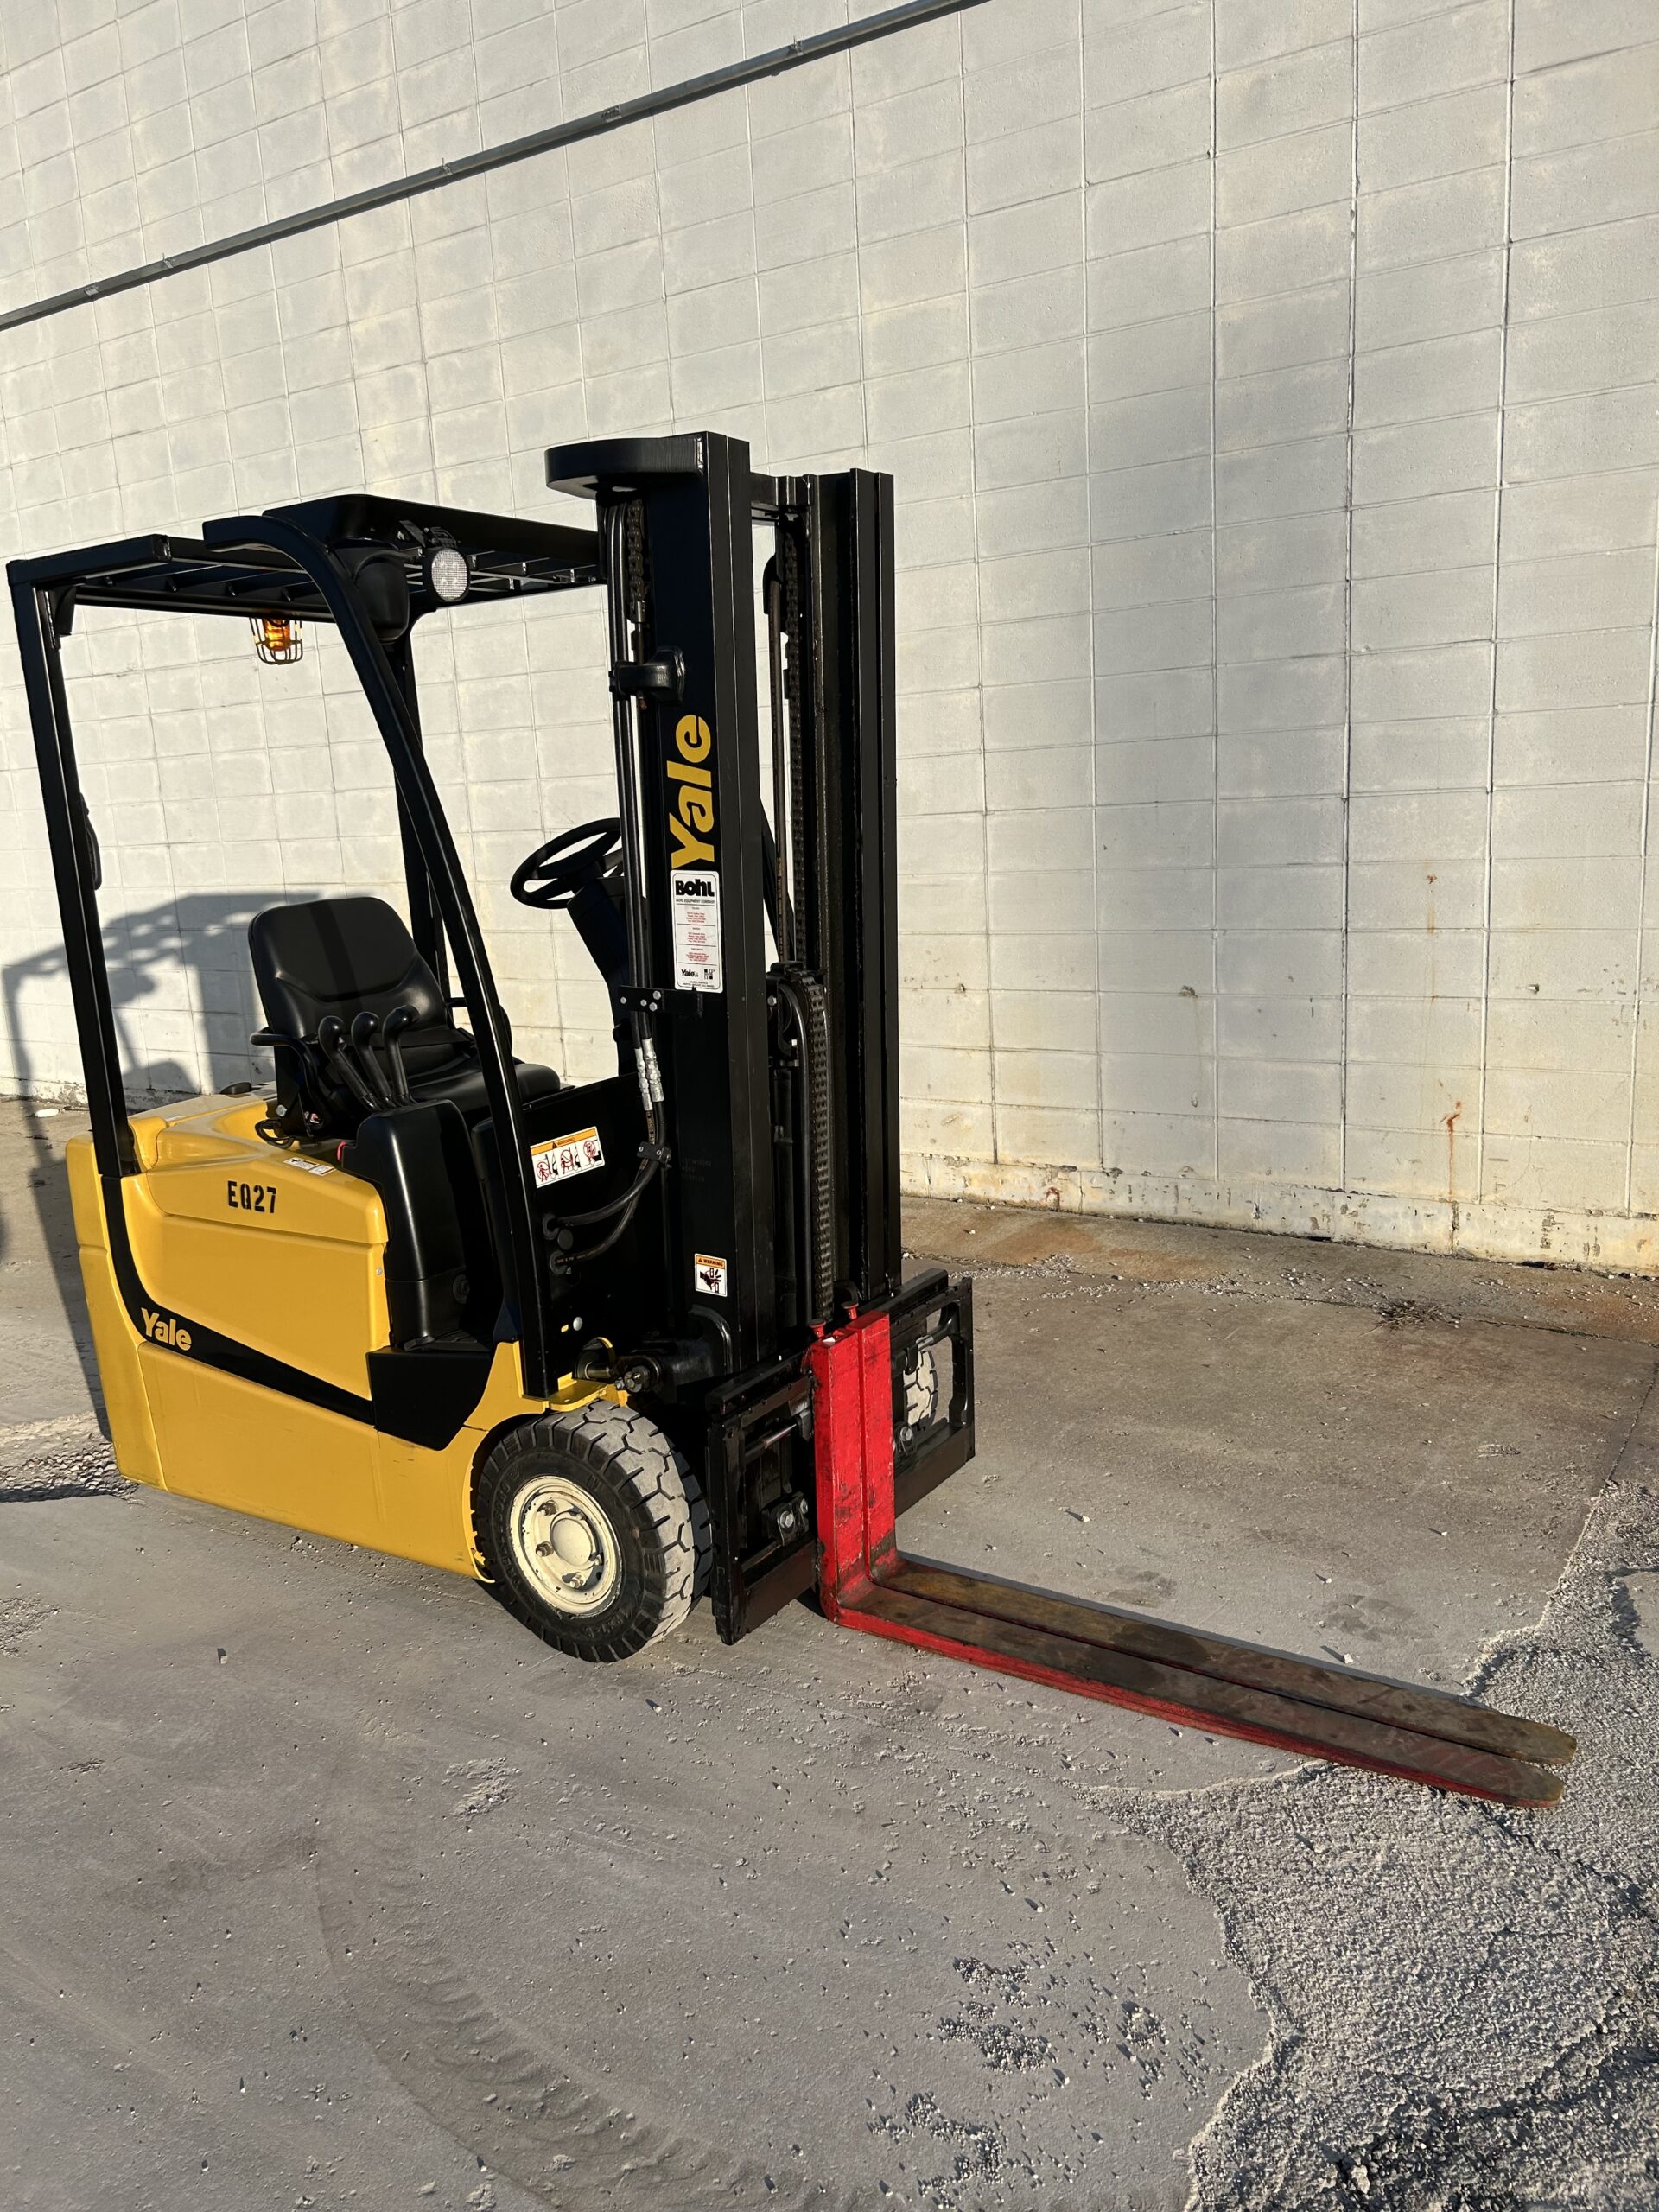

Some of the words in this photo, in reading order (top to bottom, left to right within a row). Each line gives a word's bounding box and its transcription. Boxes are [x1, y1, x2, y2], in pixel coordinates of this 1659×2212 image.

[667, 715, 715, 869] Yale
[681, 969, 695, 977] Yale
[227, 1180, 276, 1214] EQ27
[703, 1258, 723, 1267] WARNING
[141, 1307, 192, 1351] Yale
